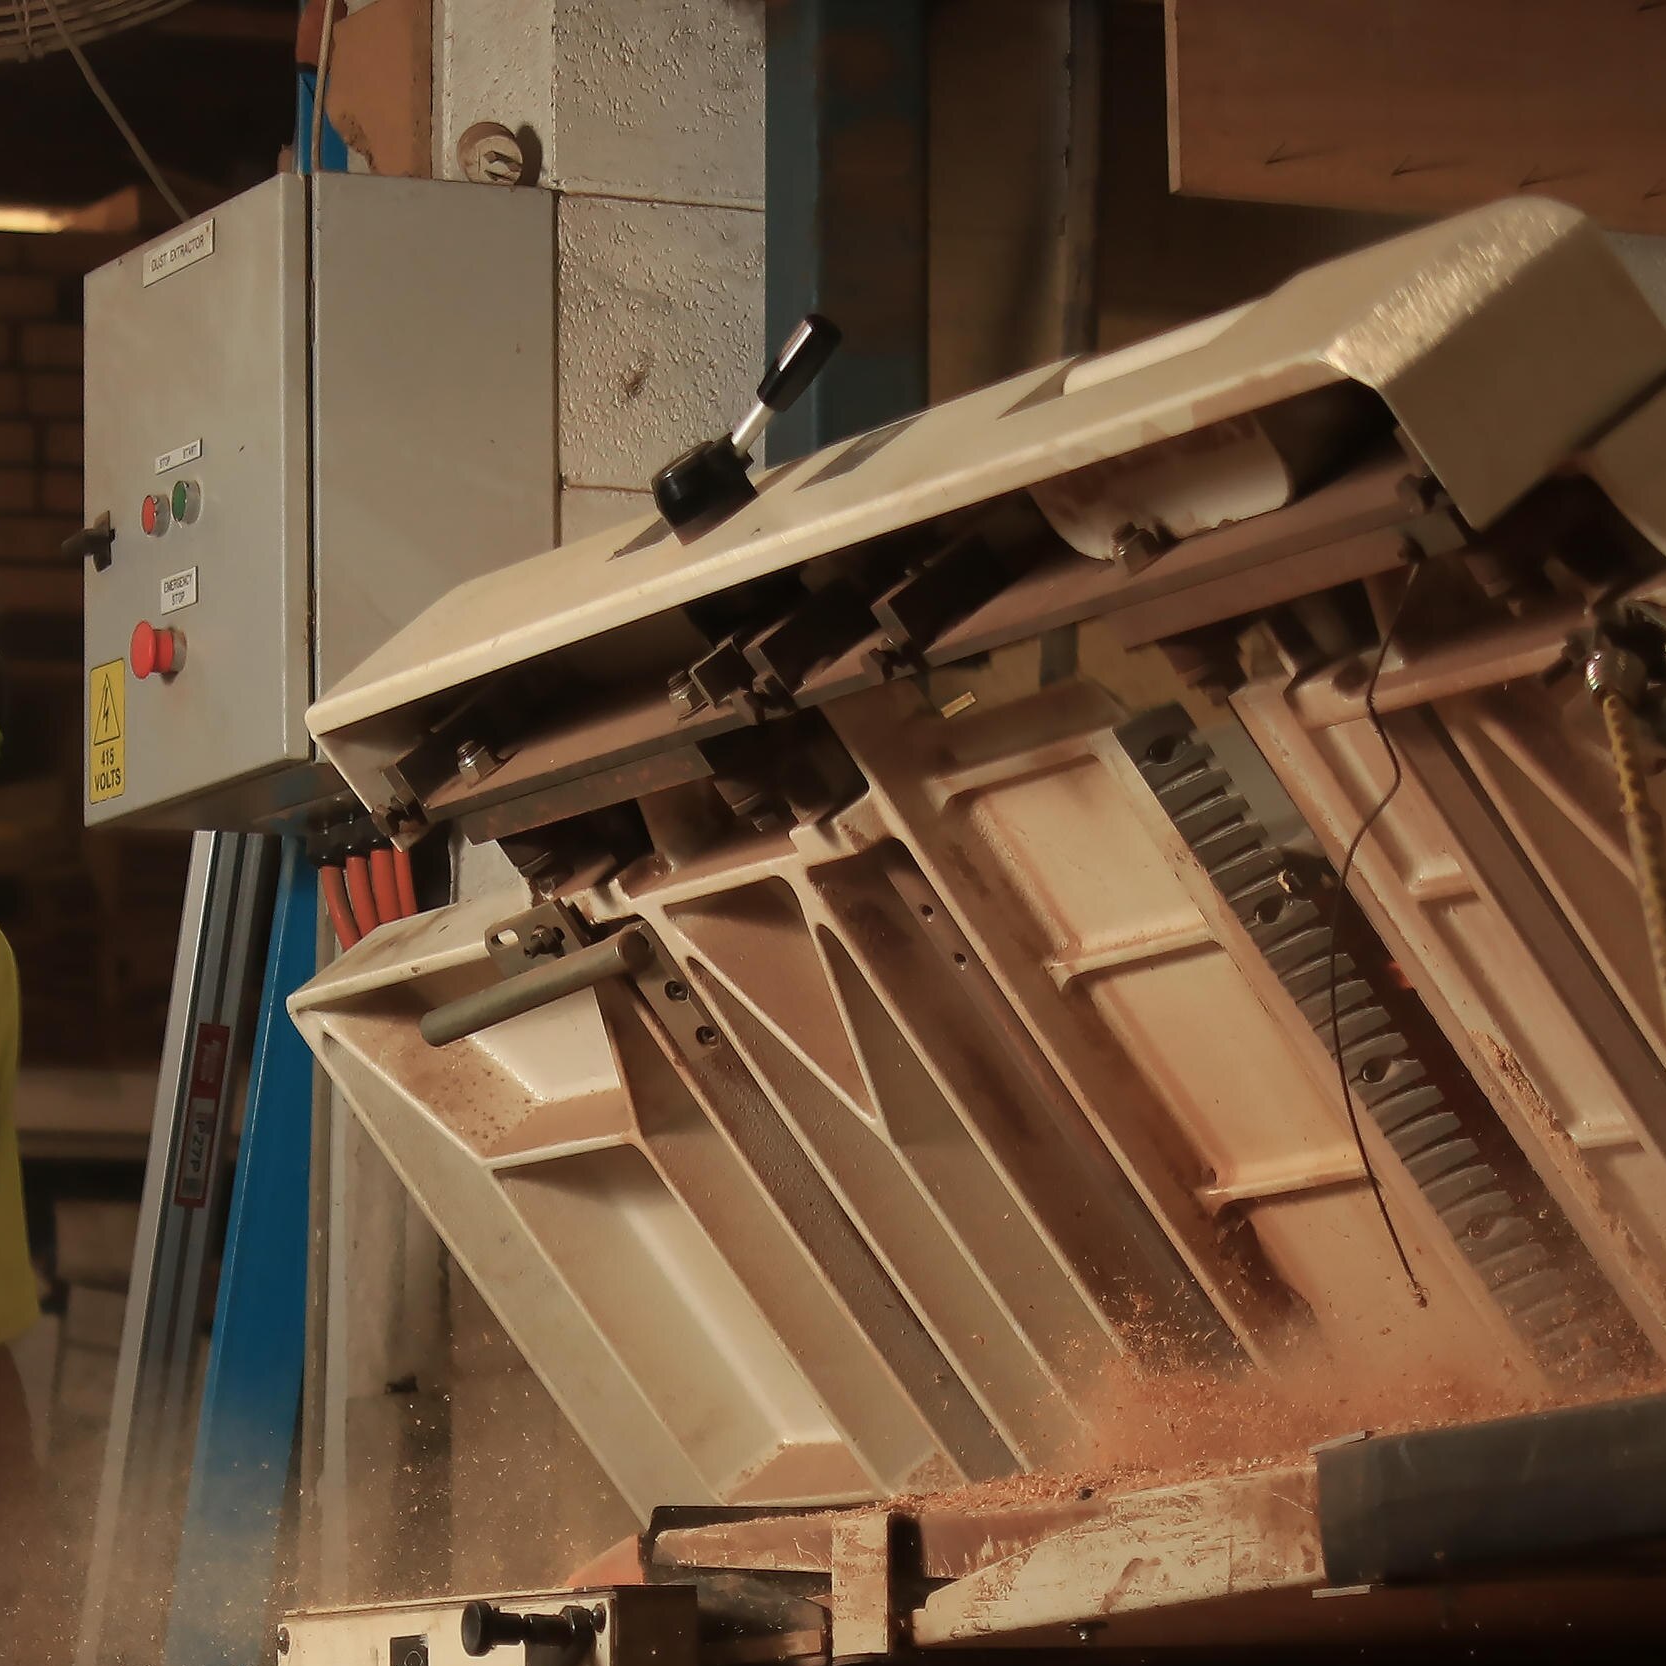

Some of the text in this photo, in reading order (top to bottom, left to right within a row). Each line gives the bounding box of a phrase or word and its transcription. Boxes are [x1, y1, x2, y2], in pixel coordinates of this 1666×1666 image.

[150, 234, 205, 272] DUST EXTRACTOR
[158, 443, 198, 470] STOP START
[163, 573, 193, 594] EMERGENCY
[171, 591, 186, 606] STOP
[101, 748, 115, 767] 415
[94, 767, 121, 792] VOLTS
